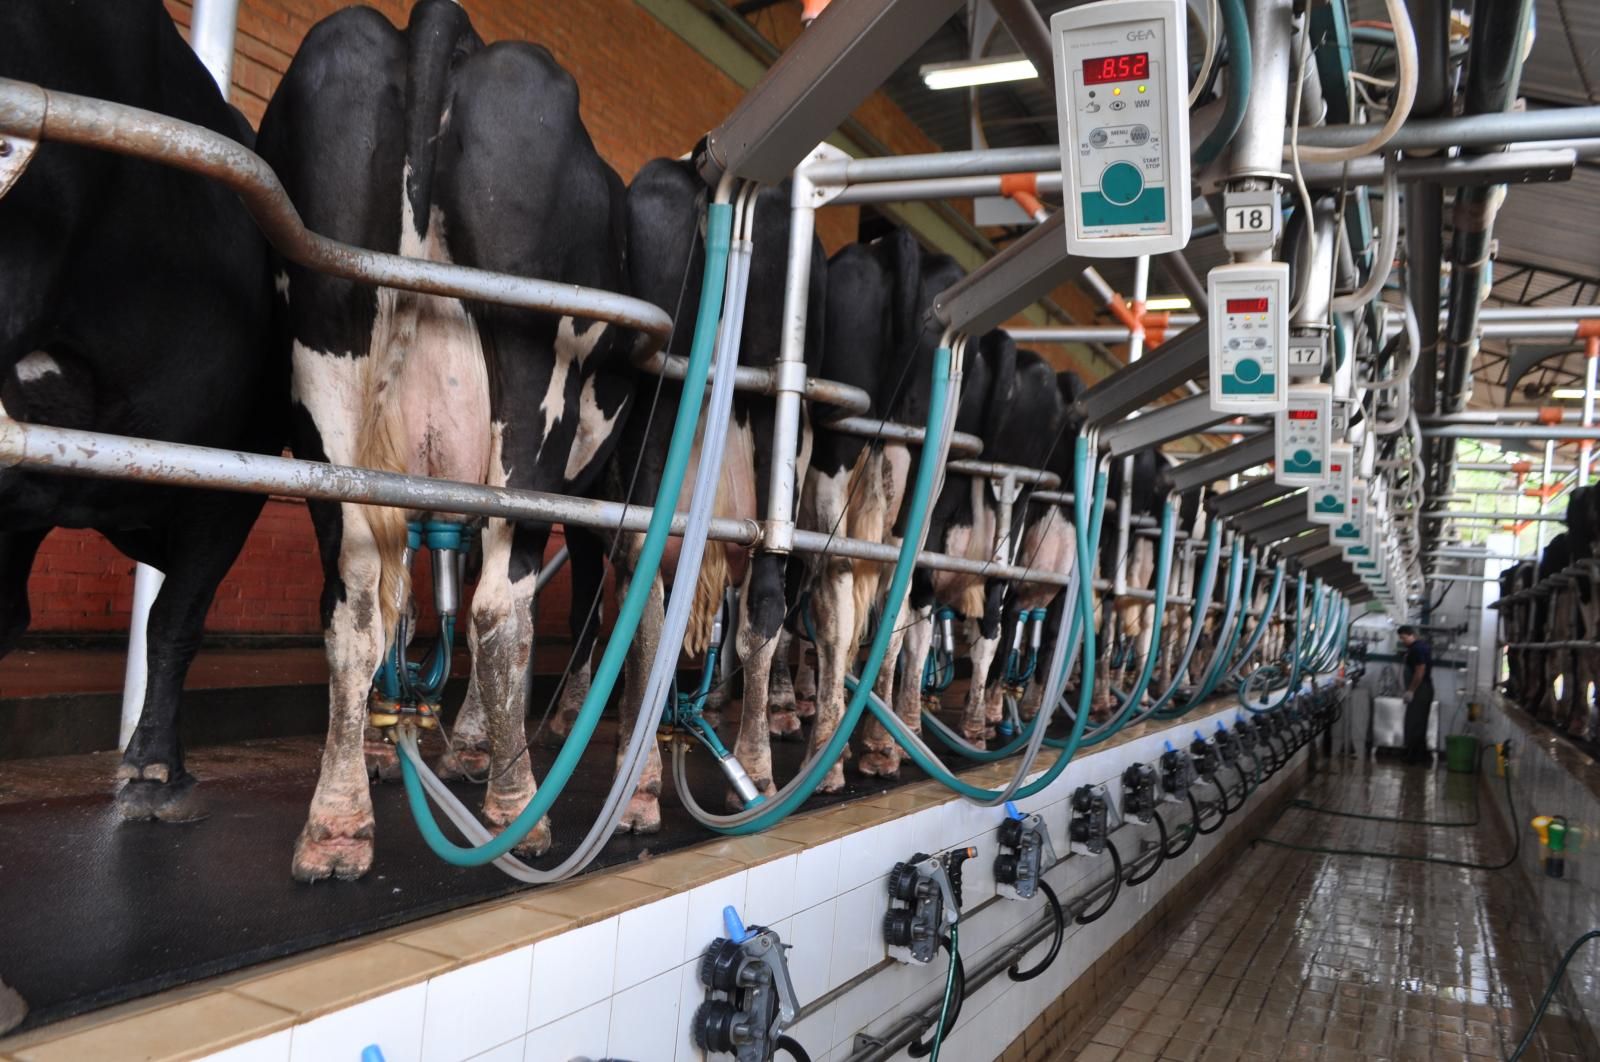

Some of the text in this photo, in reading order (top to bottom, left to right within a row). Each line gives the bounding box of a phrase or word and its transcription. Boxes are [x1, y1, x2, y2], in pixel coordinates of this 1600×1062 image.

[1126, 29, 1156, 42] GEA
[1110, 129, 1129, 137] MENU
[1235, 209, 1263, 230] 18
[1295, 349, 1315, 363] 17
